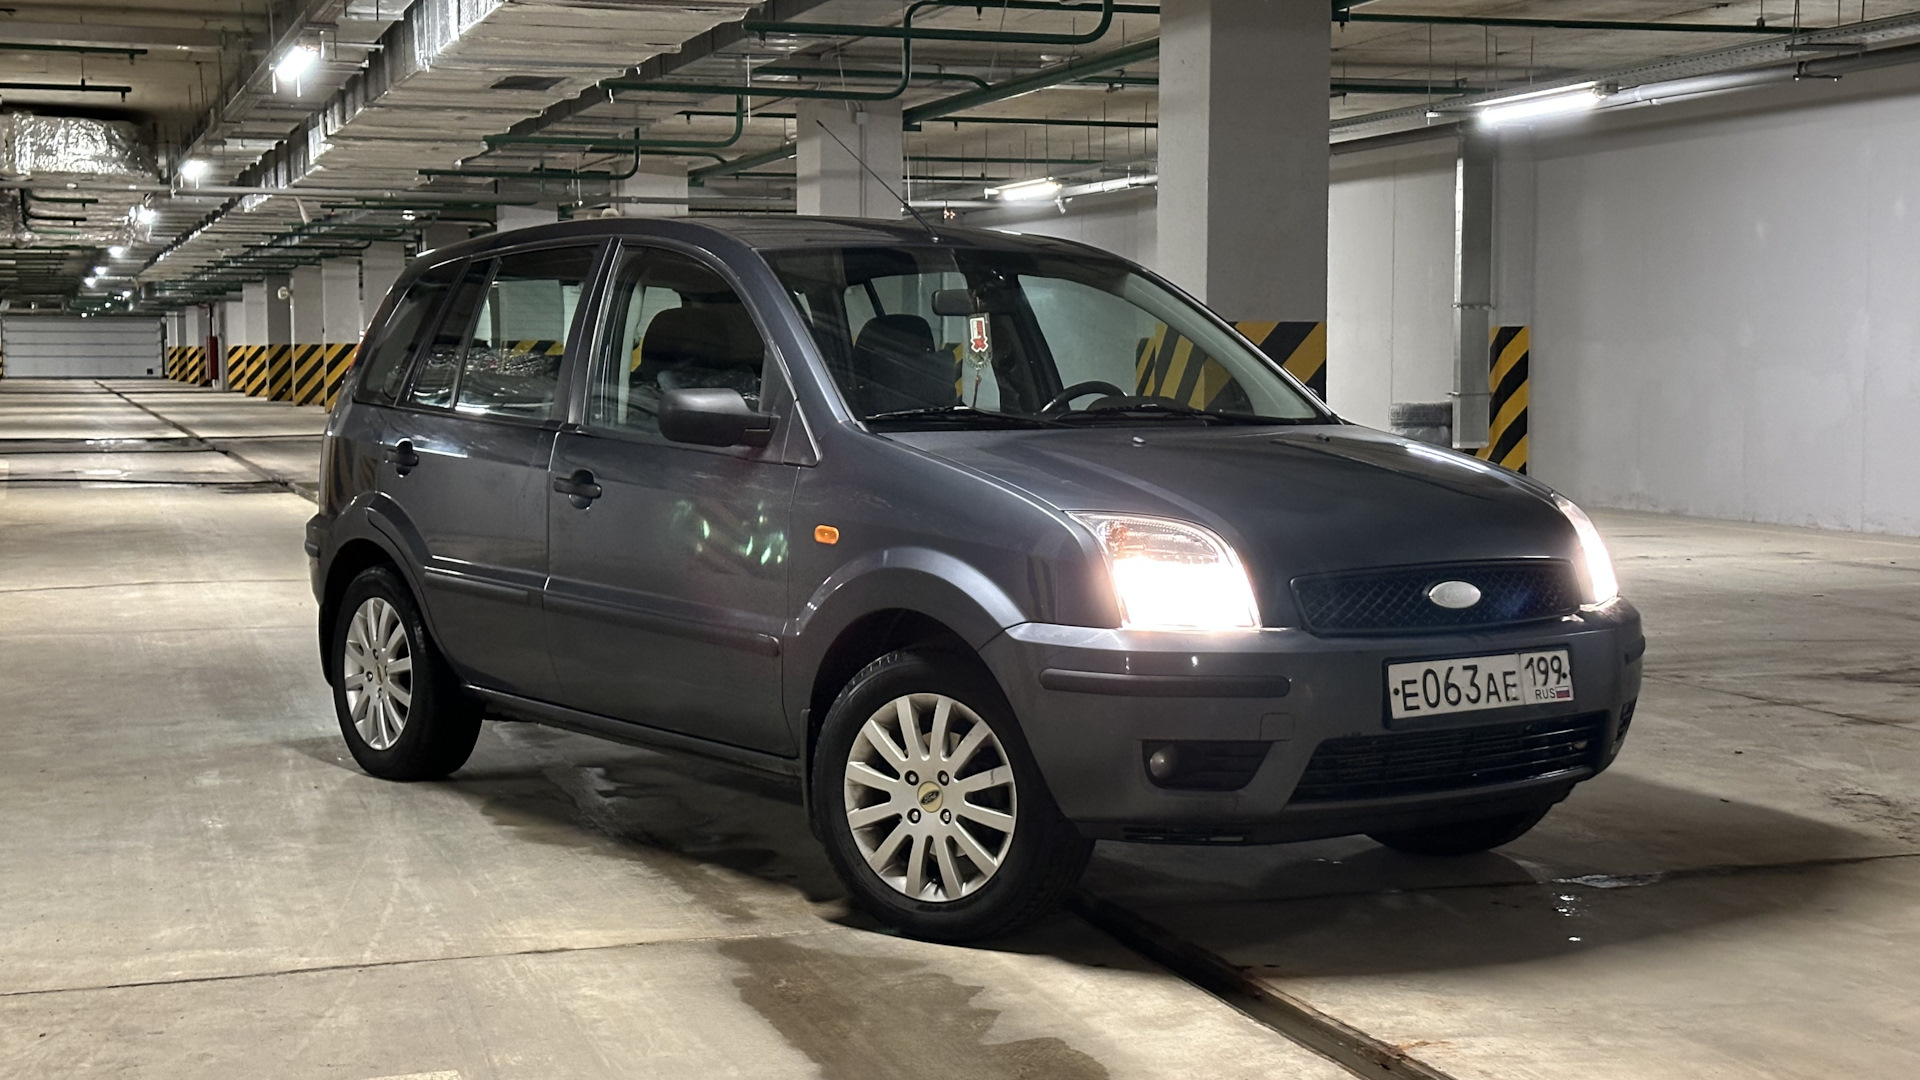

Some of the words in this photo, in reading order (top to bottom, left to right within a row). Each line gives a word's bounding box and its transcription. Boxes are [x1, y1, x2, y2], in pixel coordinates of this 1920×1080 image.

[1401, 664, 1519, 711] E063AE
[1525, 655, 1562, 686] 199
[1535, 689, 1556, 700] RUS
